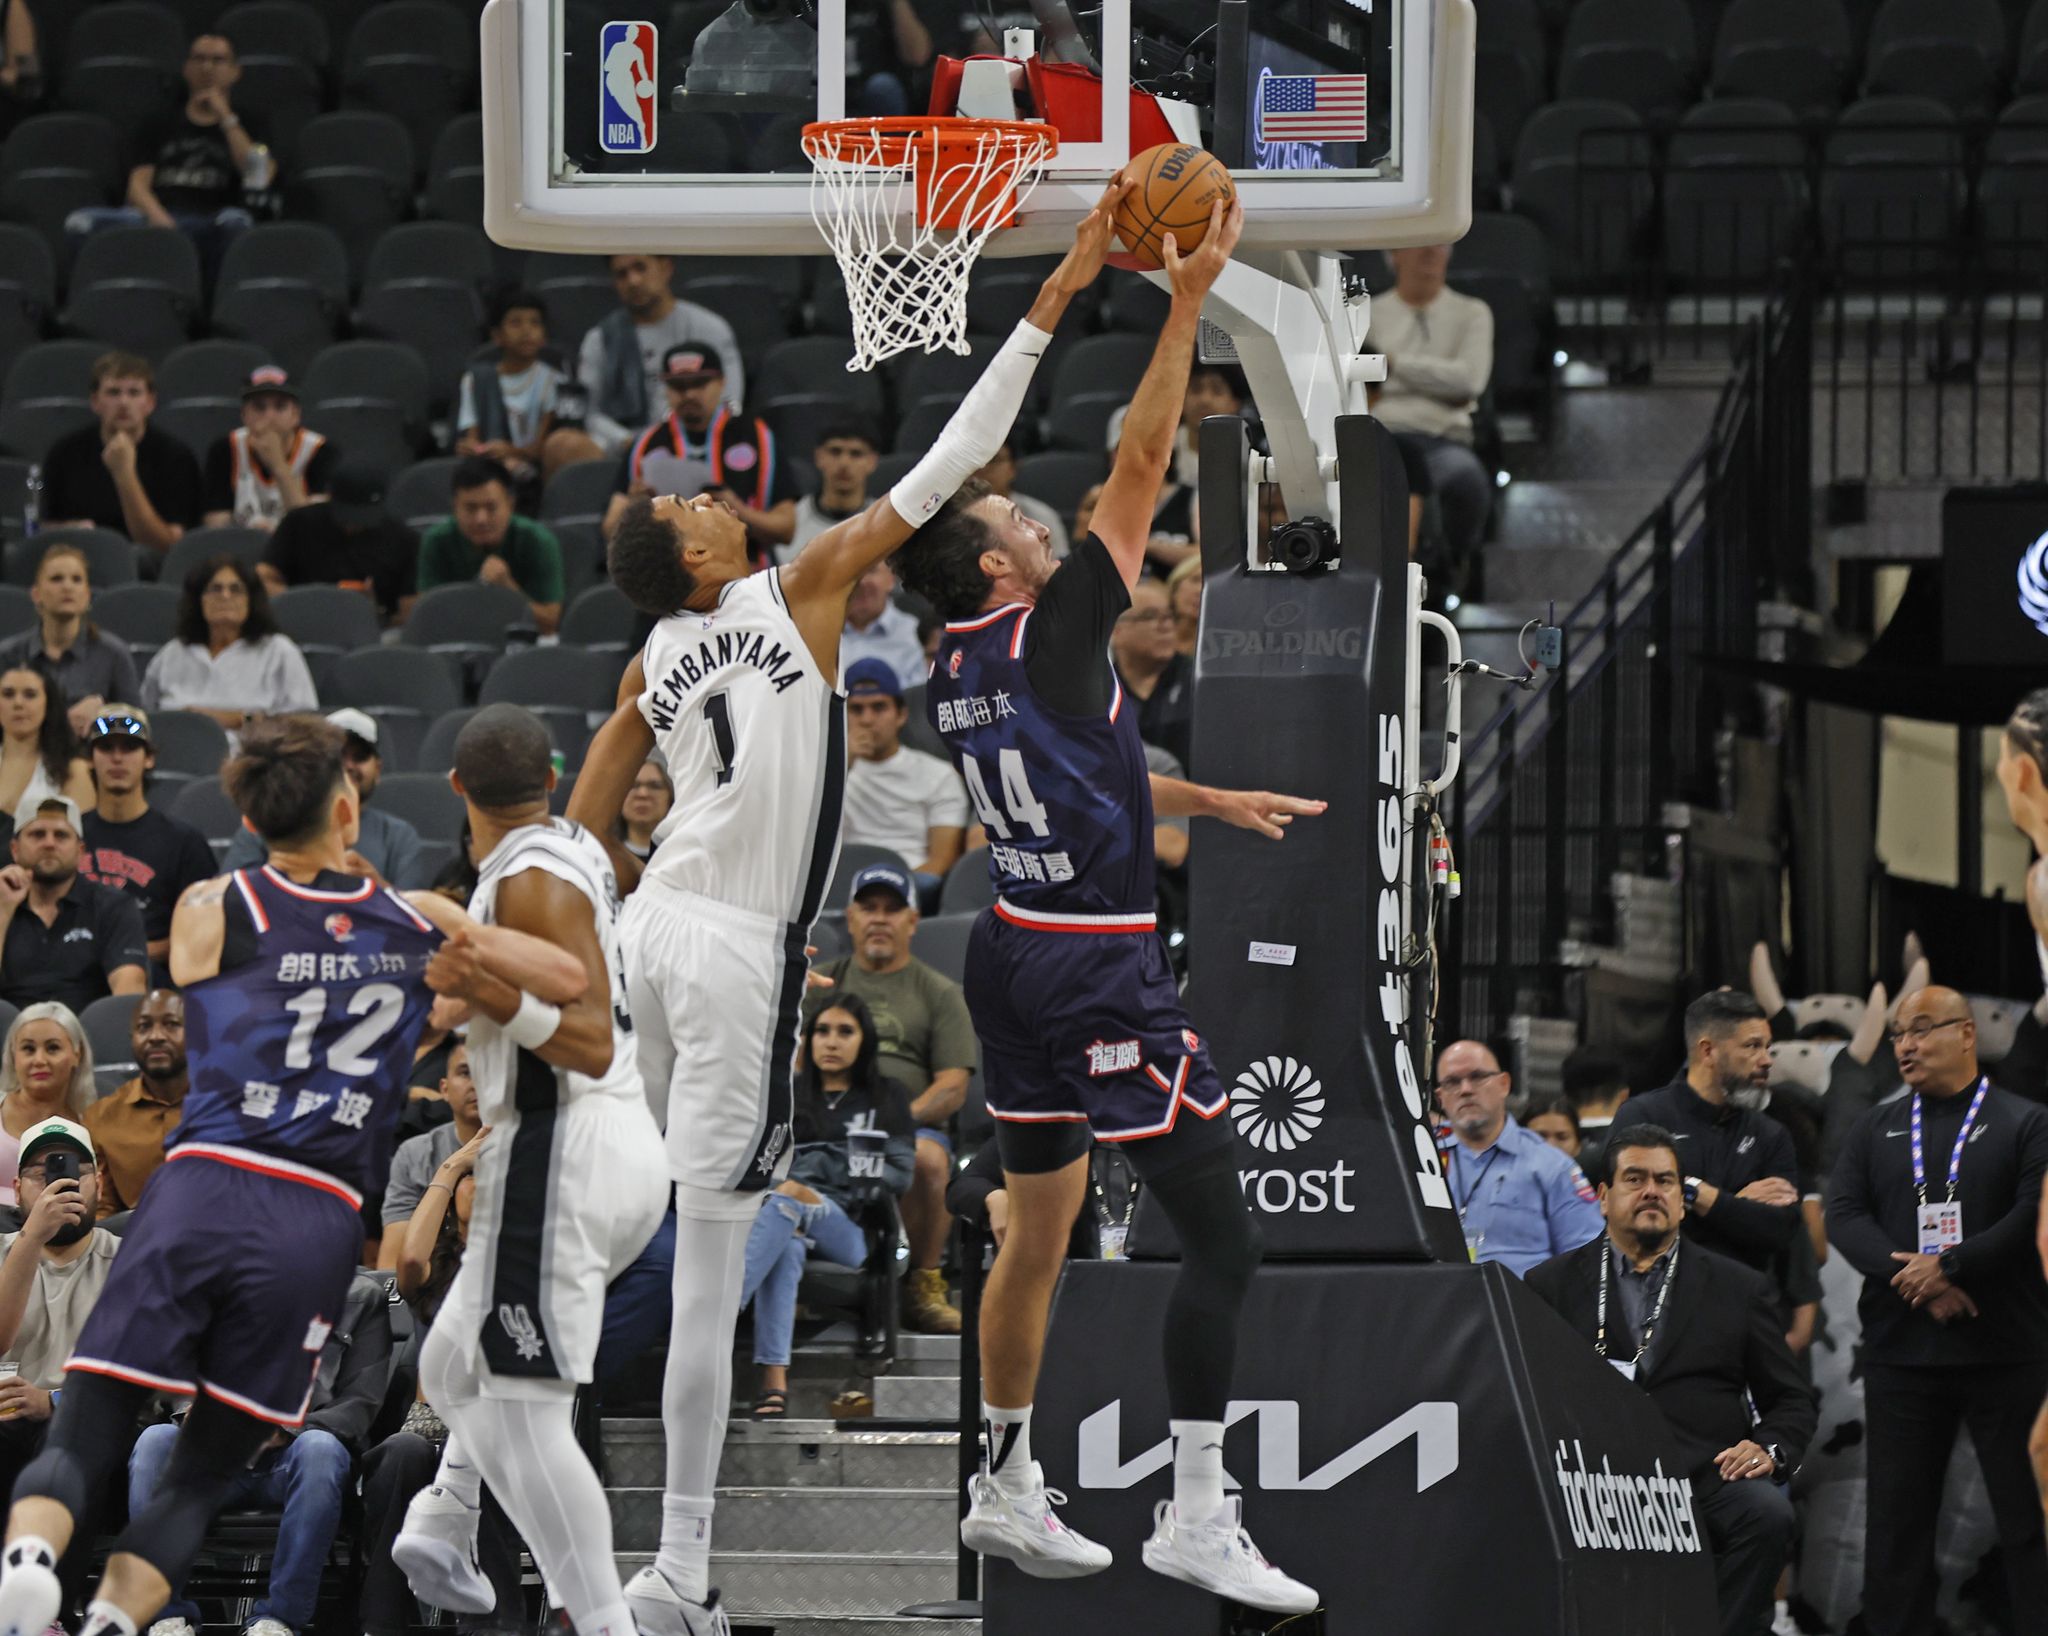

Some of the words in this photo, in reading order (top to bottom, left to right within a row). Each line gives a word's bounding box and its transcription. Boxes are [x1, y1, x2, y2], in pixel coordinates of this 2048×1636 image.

[608, 123, 635, 145] NBA
[652, 632, 804, 732] WEMBANYAMA
[1200, 625, 1362, 662] SPALDING
[701, 688, 738, 791] 1
[962, 748, 1050, 840] 44
[1377, 713, 1453, 1210] bet365
[284, 982, 405, 1077] 12
[1237, 1159, 1356, 1213] rost
[1555, 1438, 1702, 1554] ticketmaster
